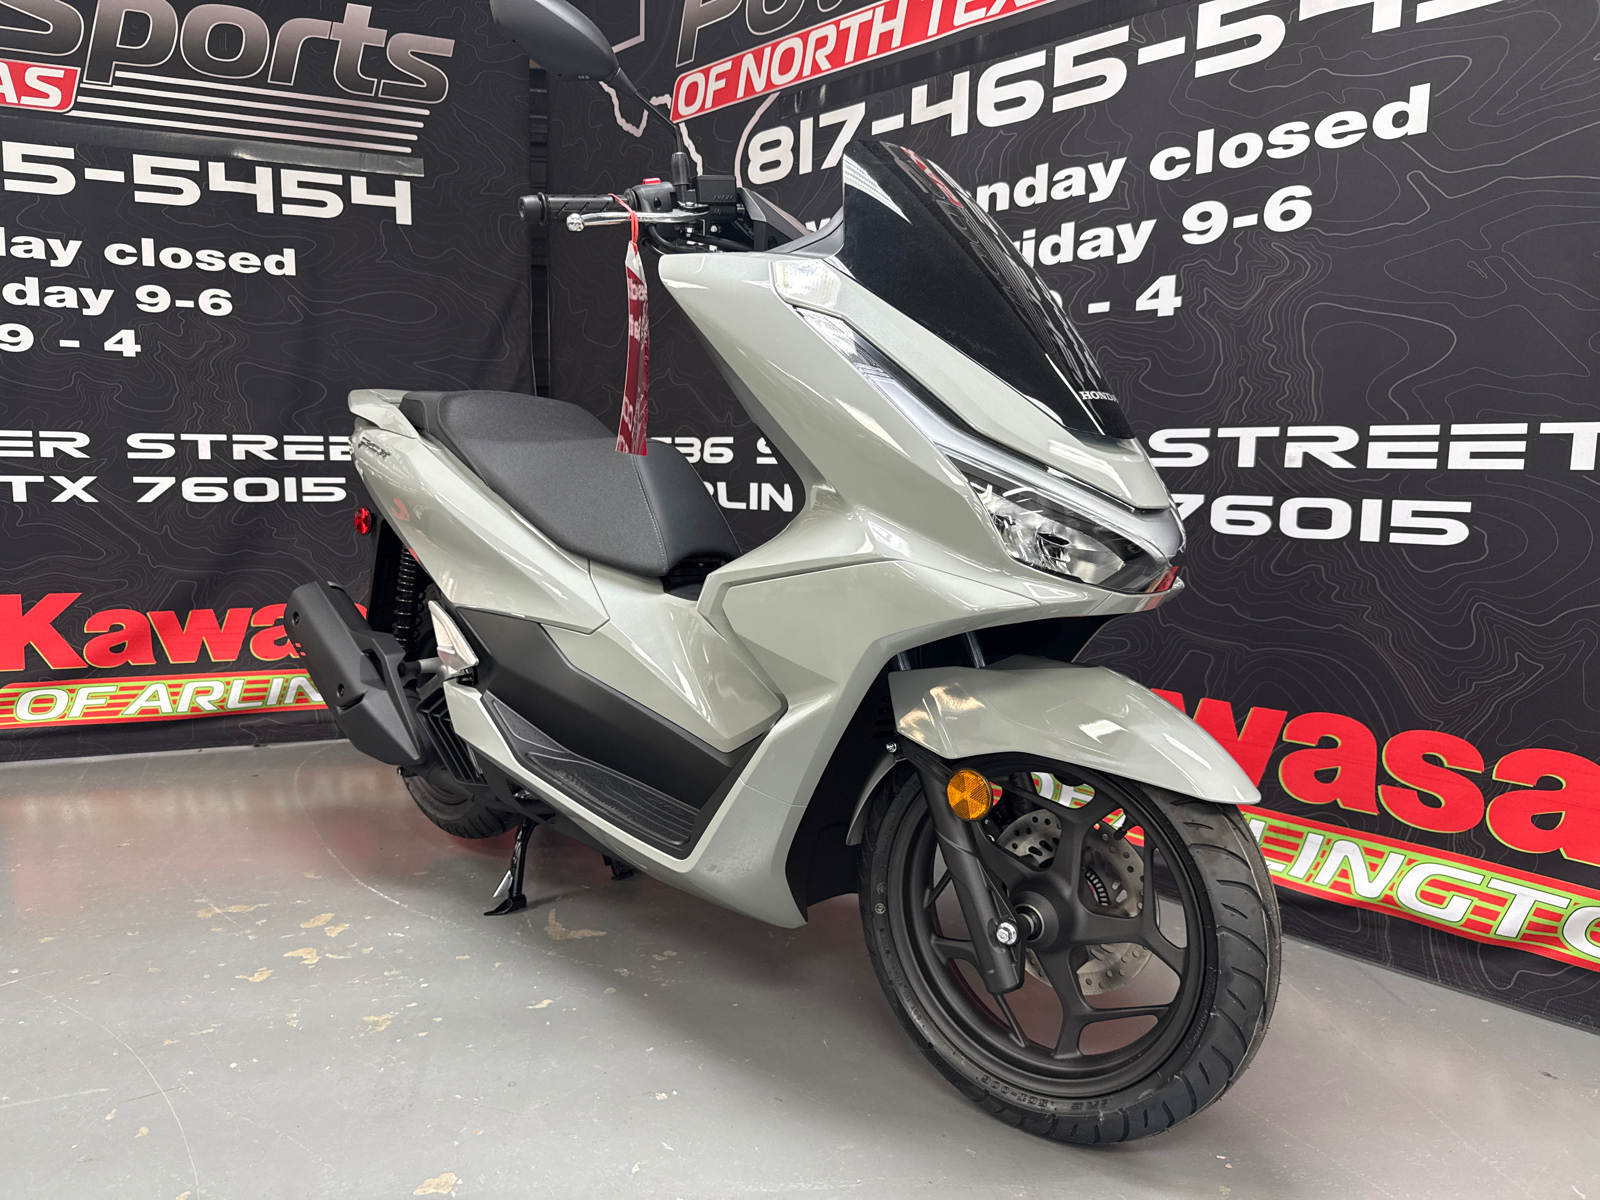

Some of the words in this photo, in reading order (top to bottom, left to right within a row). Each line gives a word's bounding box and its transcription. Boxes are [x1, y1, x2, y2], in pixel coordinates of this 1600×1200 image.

[677, 61, 737, 117] OF
[736, 0, 906, 99] NORTH
[747, 0, 1517, 184] 817-465-5
[965, 157, 1127, 212] nday
[1149, 83, 1430, 180] closed
[2, 141, 412, 225] 5-5454
[1015, 219, 1157, 268] iday
[1181, 185, 1313, 244] 9-6
[0, 226, 83, 267] ay
[103, 237, 297, 277] closed
[2, 276, 114, 316] day
[135, 284, 233, 317] 9-6
[1136, 275, 1183, 317] 4
[0, 323, 34, 352] 9
[103, 329, 142, 357] 4
[0, 430, 91, 459] ER
[650, 436, 734, 464] 36
[1149, 422, 1600, 470] STREET
[0, 475, 99, 503] TX
[133, 476, 348, 503] 76015
[703, 481, 793, 512] LIN
[0, 592, 367, 671] Kawa
[15, 685, 118, 720] OF
